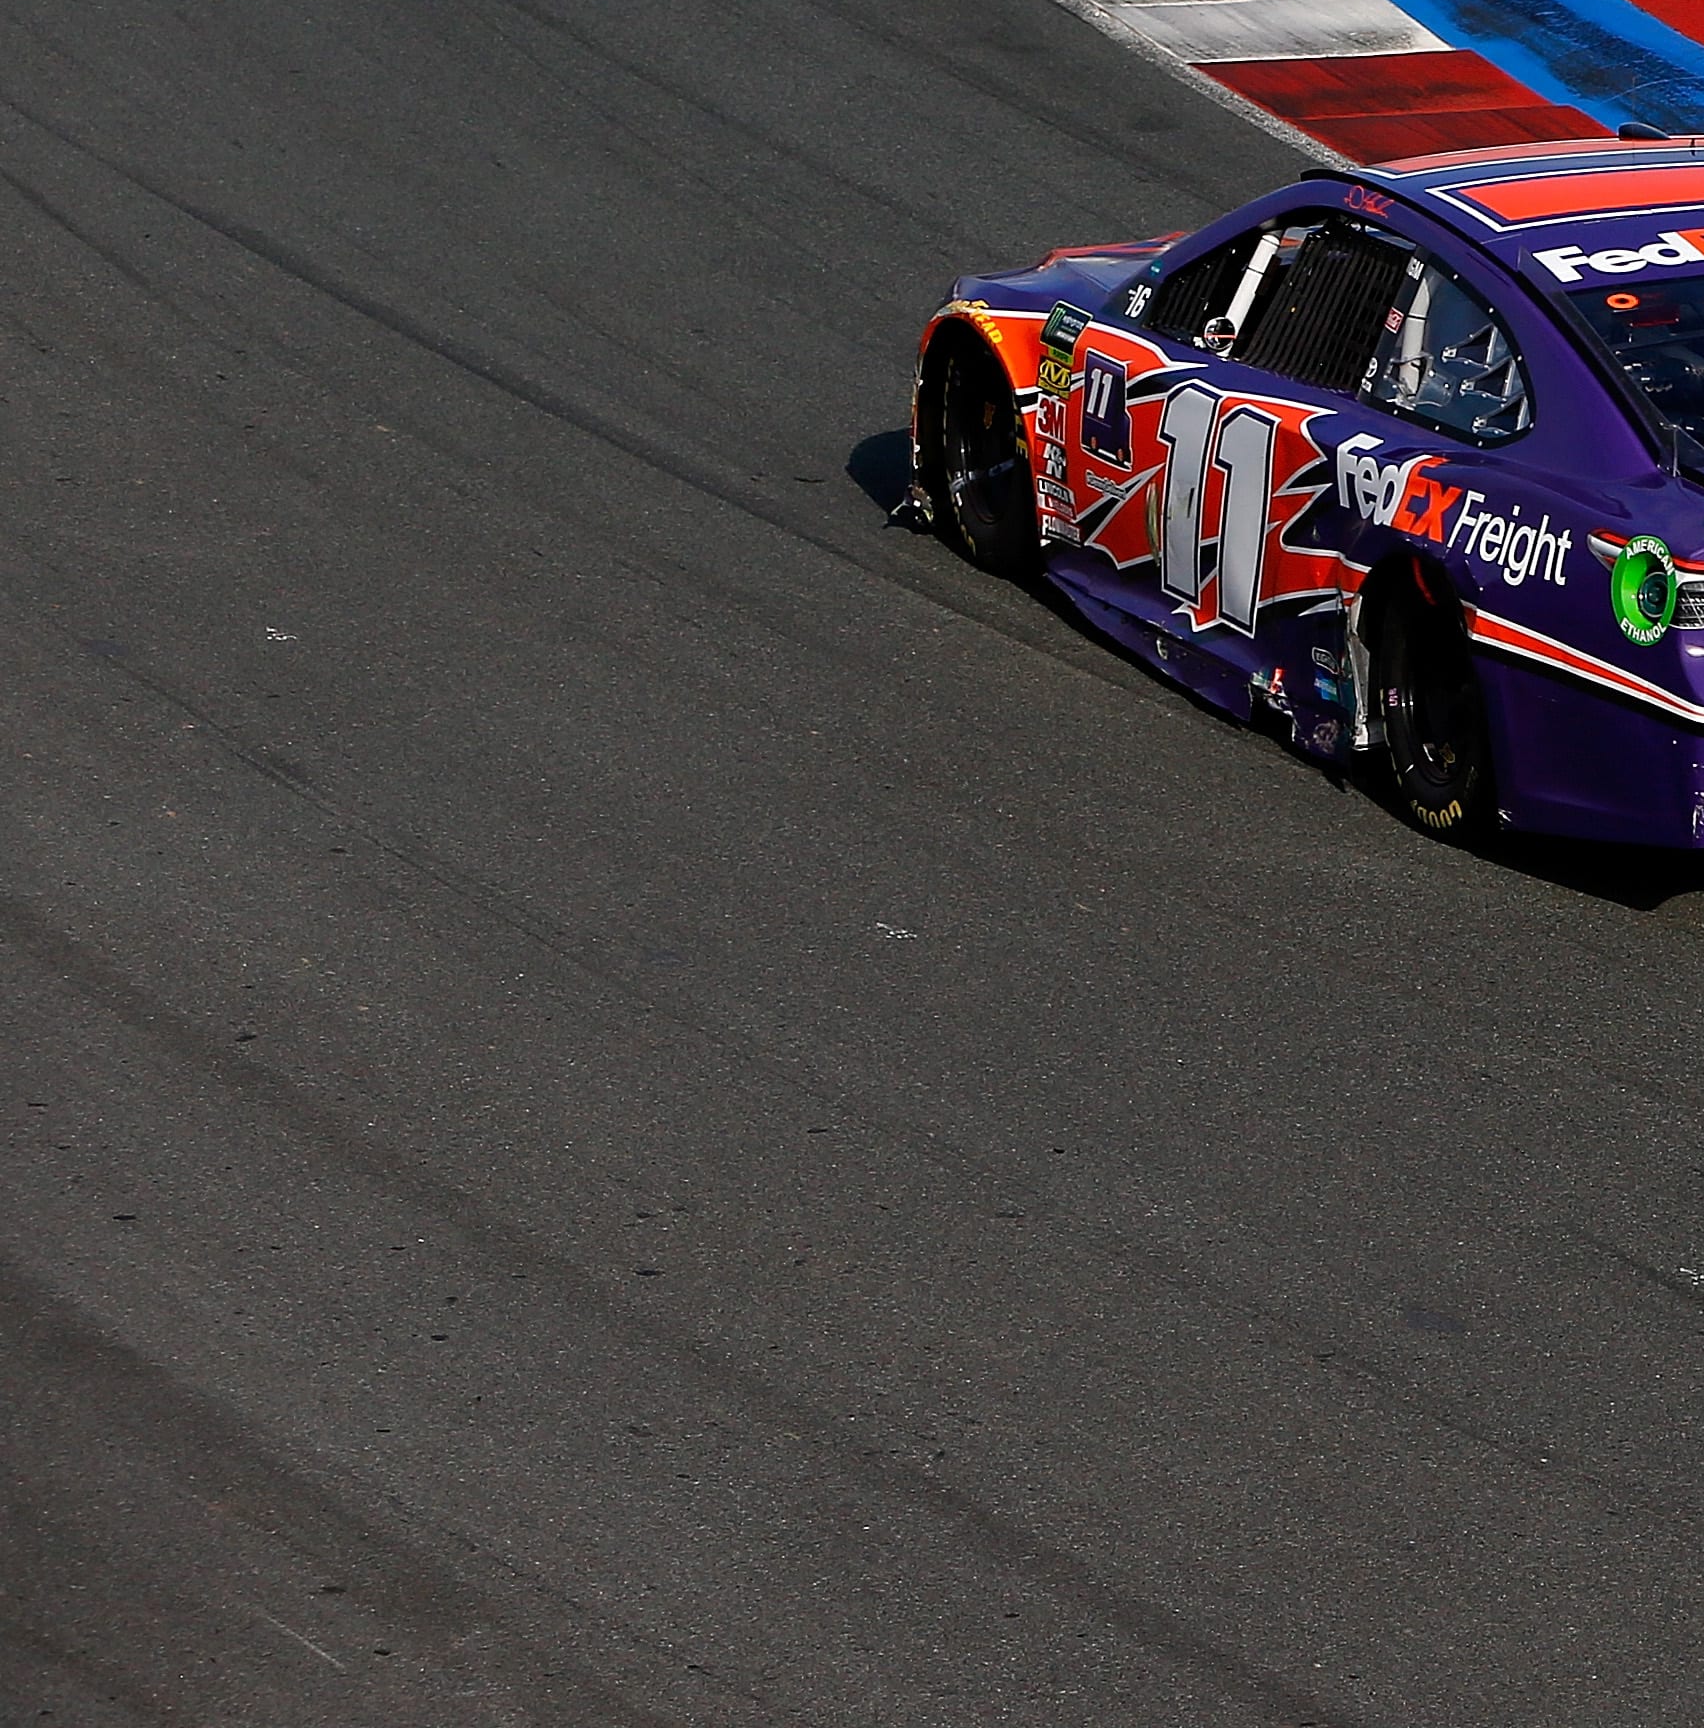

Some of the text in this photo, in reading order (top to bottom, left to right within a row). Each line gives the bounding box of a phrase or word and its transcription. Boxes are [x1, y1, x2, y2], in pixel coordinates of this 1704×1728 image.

[1086, 368, 1113, 419] 11
[1038, 396, 1066, 444] 3M
[1158, 379, 1281, 639] 11
[1337, 433, 1571, 586] FedEx Freight
[1625, 539, 1675, 576] AMERICAN
[1620, 617, 1667, 643] ETHANOL
